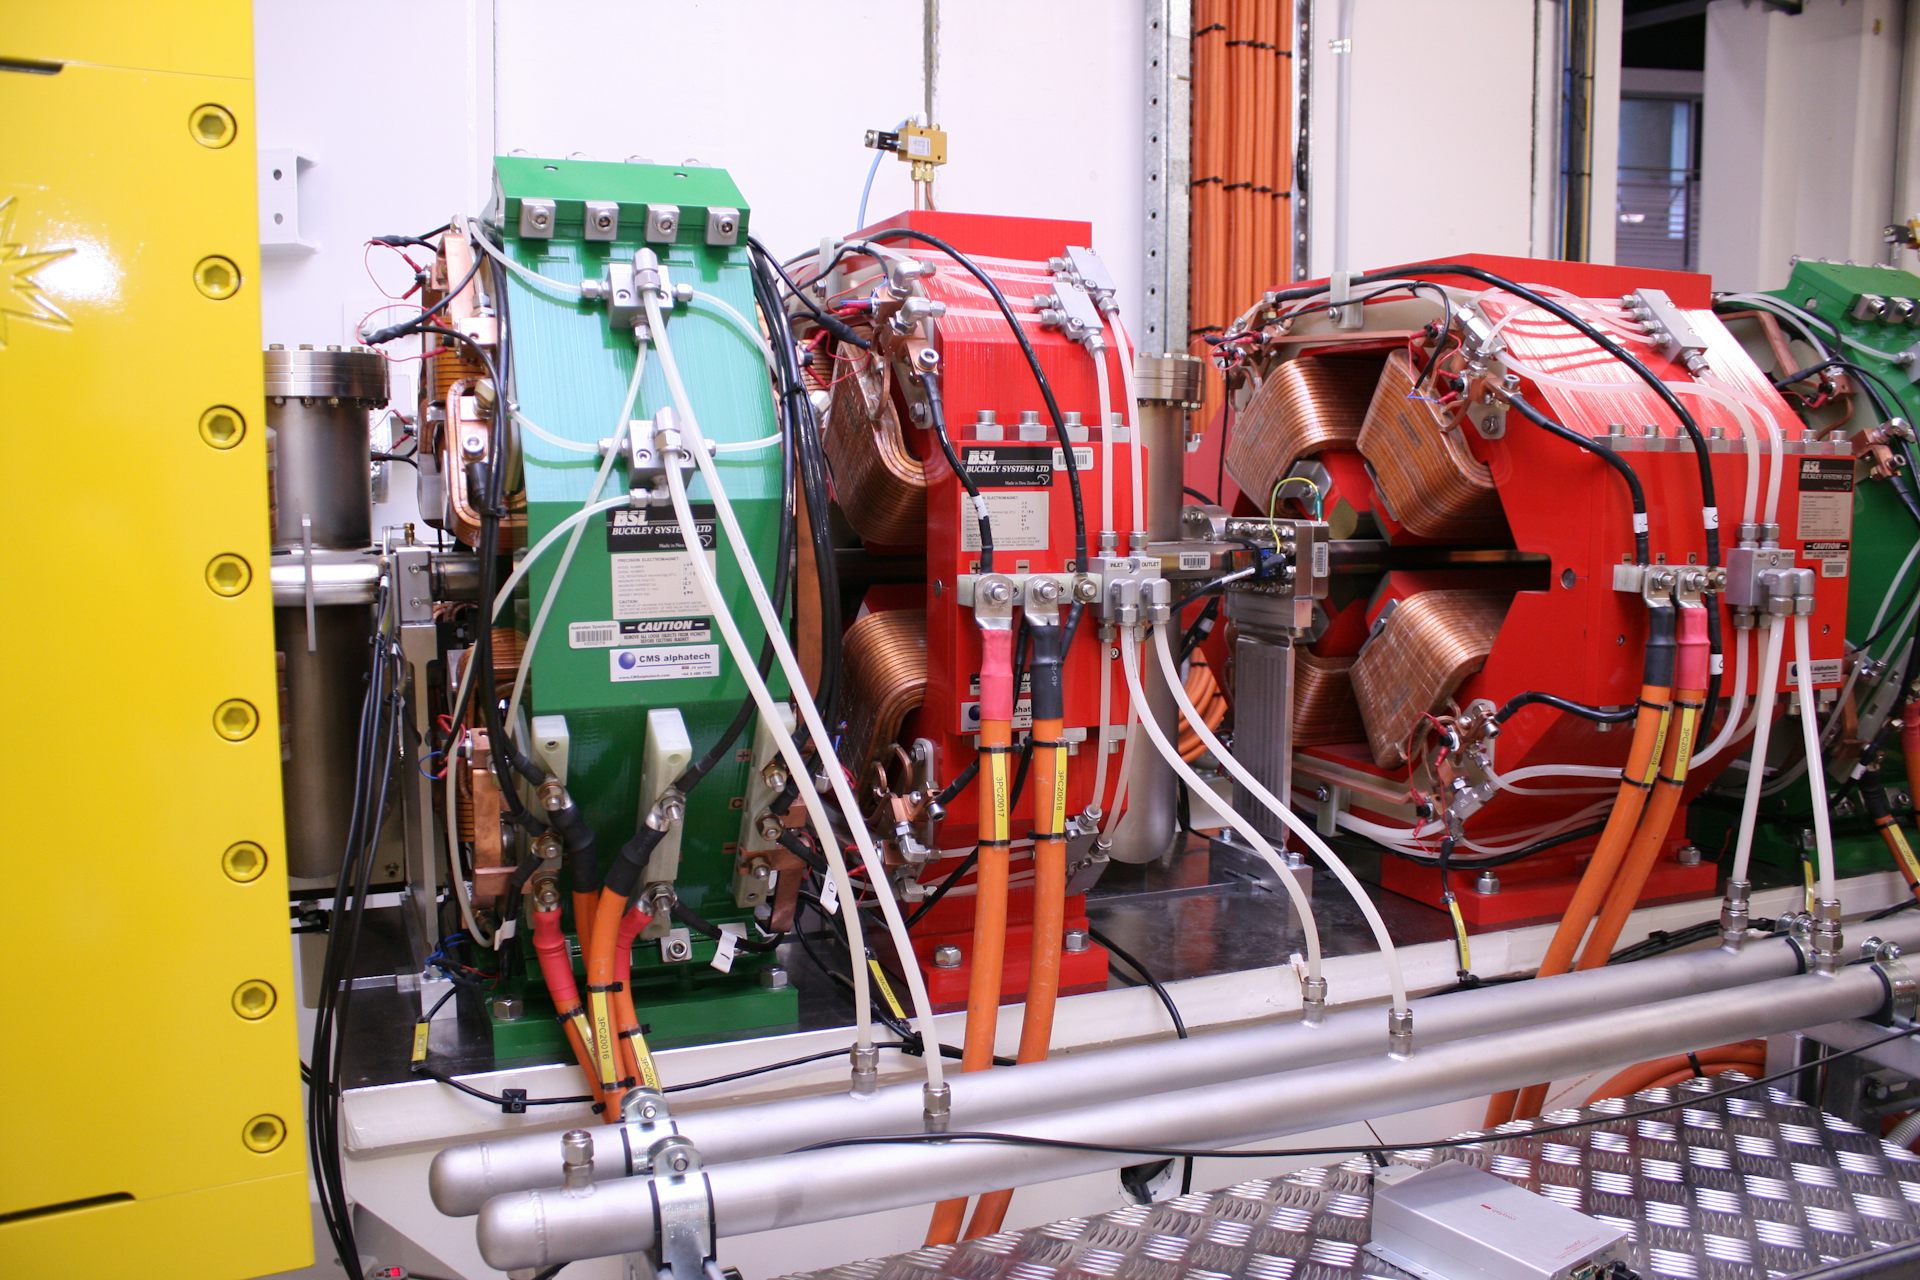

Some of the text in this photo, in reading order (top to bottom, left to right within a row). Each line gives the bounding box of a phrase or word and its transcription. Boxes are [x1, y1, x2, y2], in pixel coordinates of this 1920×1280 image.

[967, 450, 997, 465] BSL
[1001, 465, 1035, 473] SYSTEMS
[1035, 465, 1050, 473] LTD
[1802, 461, 1821, 473] BSL
[613, 510, 649, 527] BSL
[612, 524, 712, 536] BUCKLEY SYSTE LTD
[1812, 542, 1841, 550] CAUTION
[637, 620, 693, 632] CAUTION
[638, 652, 711, 663] CMS alphatech
[995, 777, 1005, 817] 3PC20017
[1056, 770, 1065, 811] 3PC20018
[597, 1017, 610, 1060] 3PC20016
[641, 1057, 656, 1088] 3PC200
